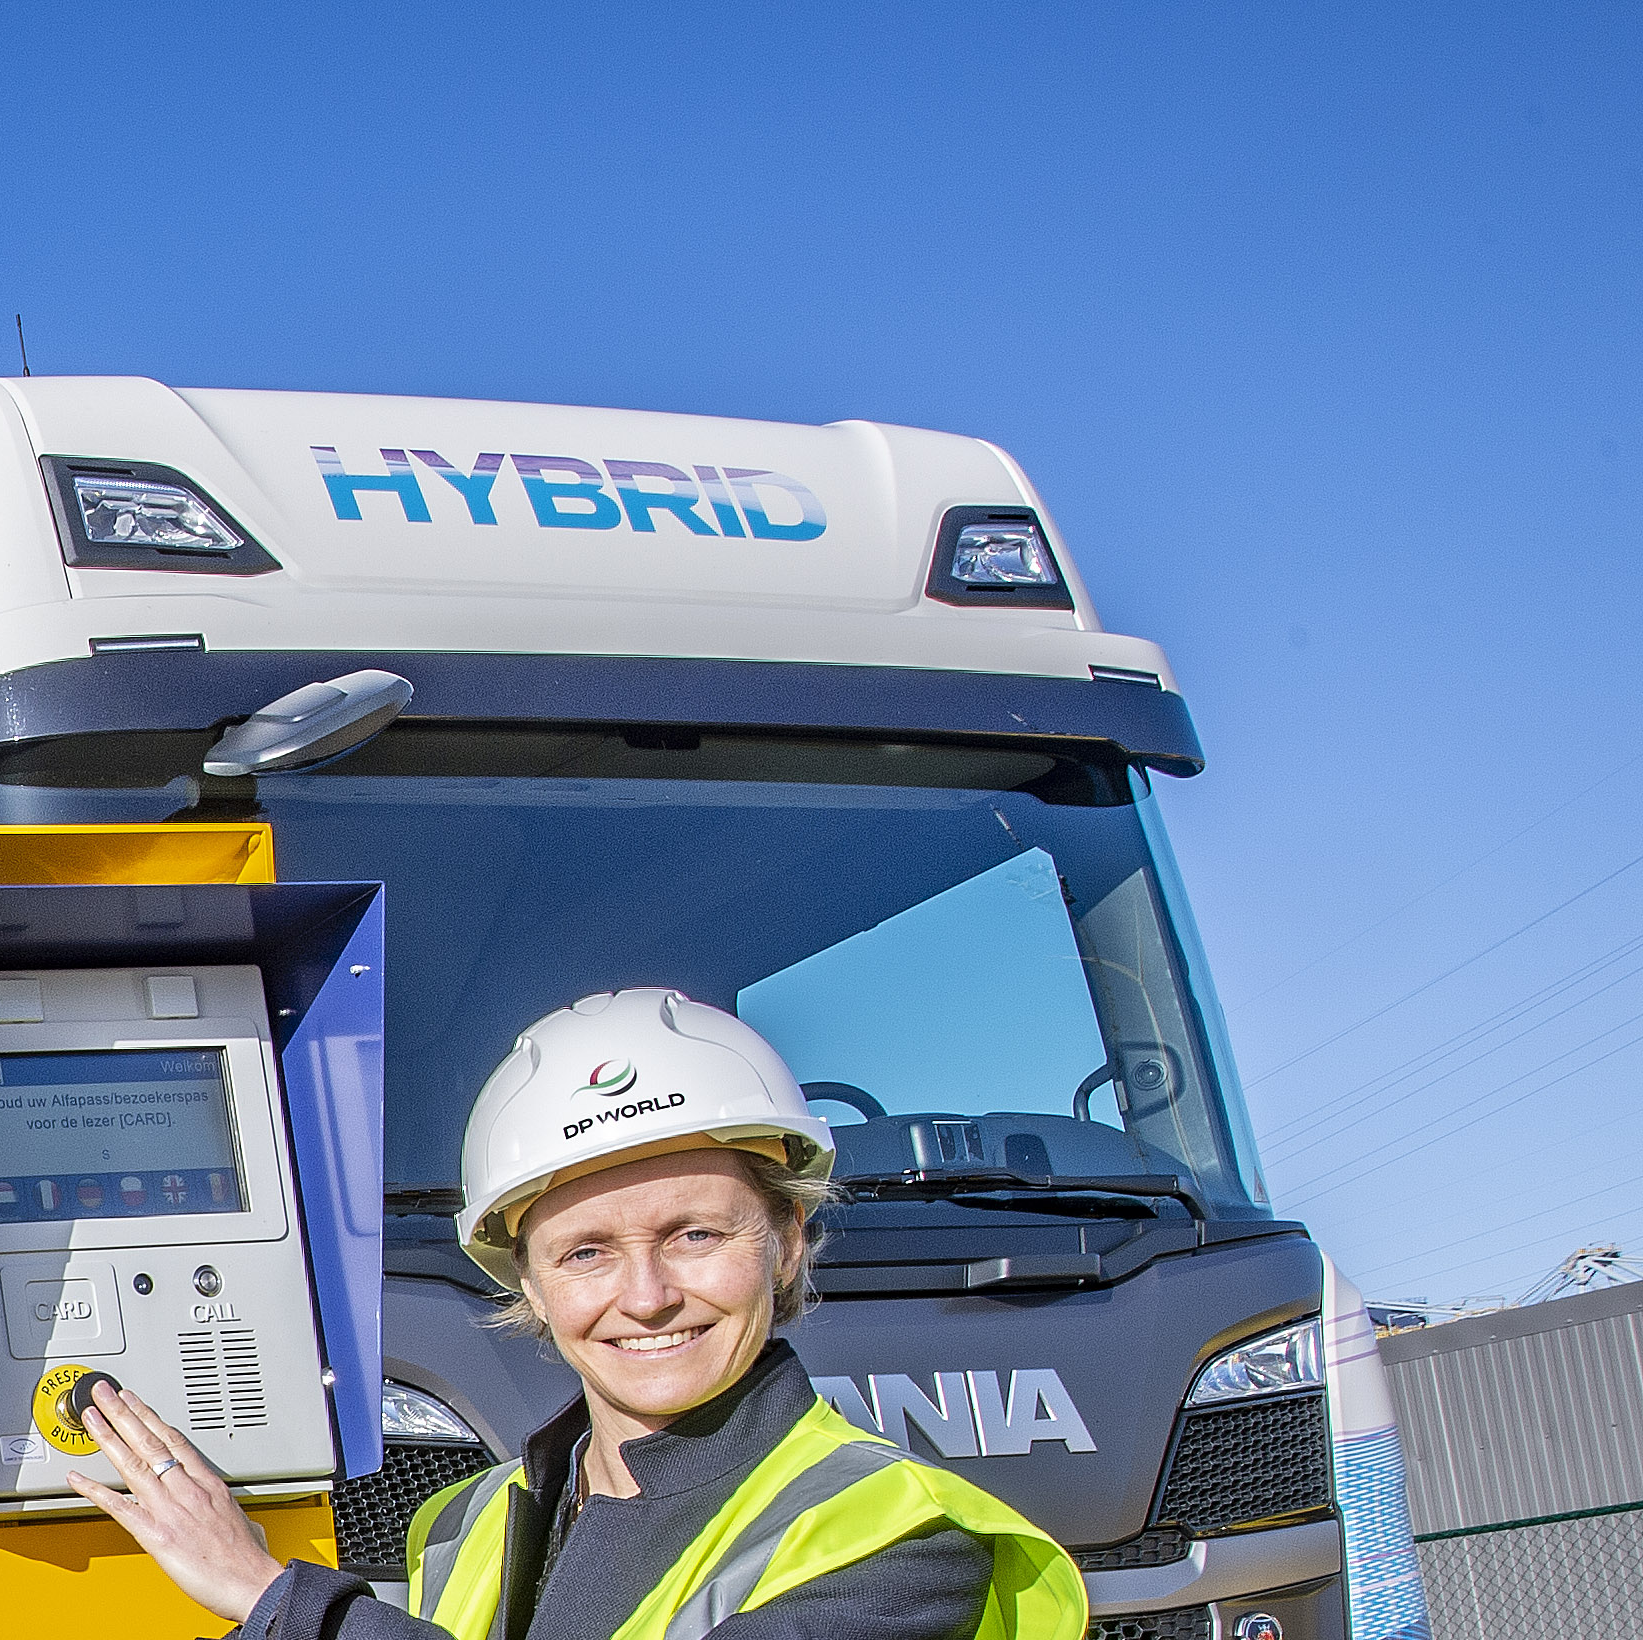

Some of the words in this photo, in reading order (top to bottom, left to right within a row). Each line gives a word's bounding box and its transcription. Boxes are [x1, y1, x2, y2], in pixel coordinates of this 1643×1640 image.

[309, 444, 827, 542] HYBRID
[27, 1097, 46, 1107] uw
[52, 1089, 209, 1109] Alfapass/bezoekerspas
[26, 1117, 56, 1130] voor
[61, 1115, 78, 1128] de
[82, 1114, 116, 1128] lezer
[563, 1118, 593, 1140] DP
[596, 1093, 685, 1124] WORLD
[35, 1301, 93, 1321] CARD
[190, 1302, 242, 1323] CALL
